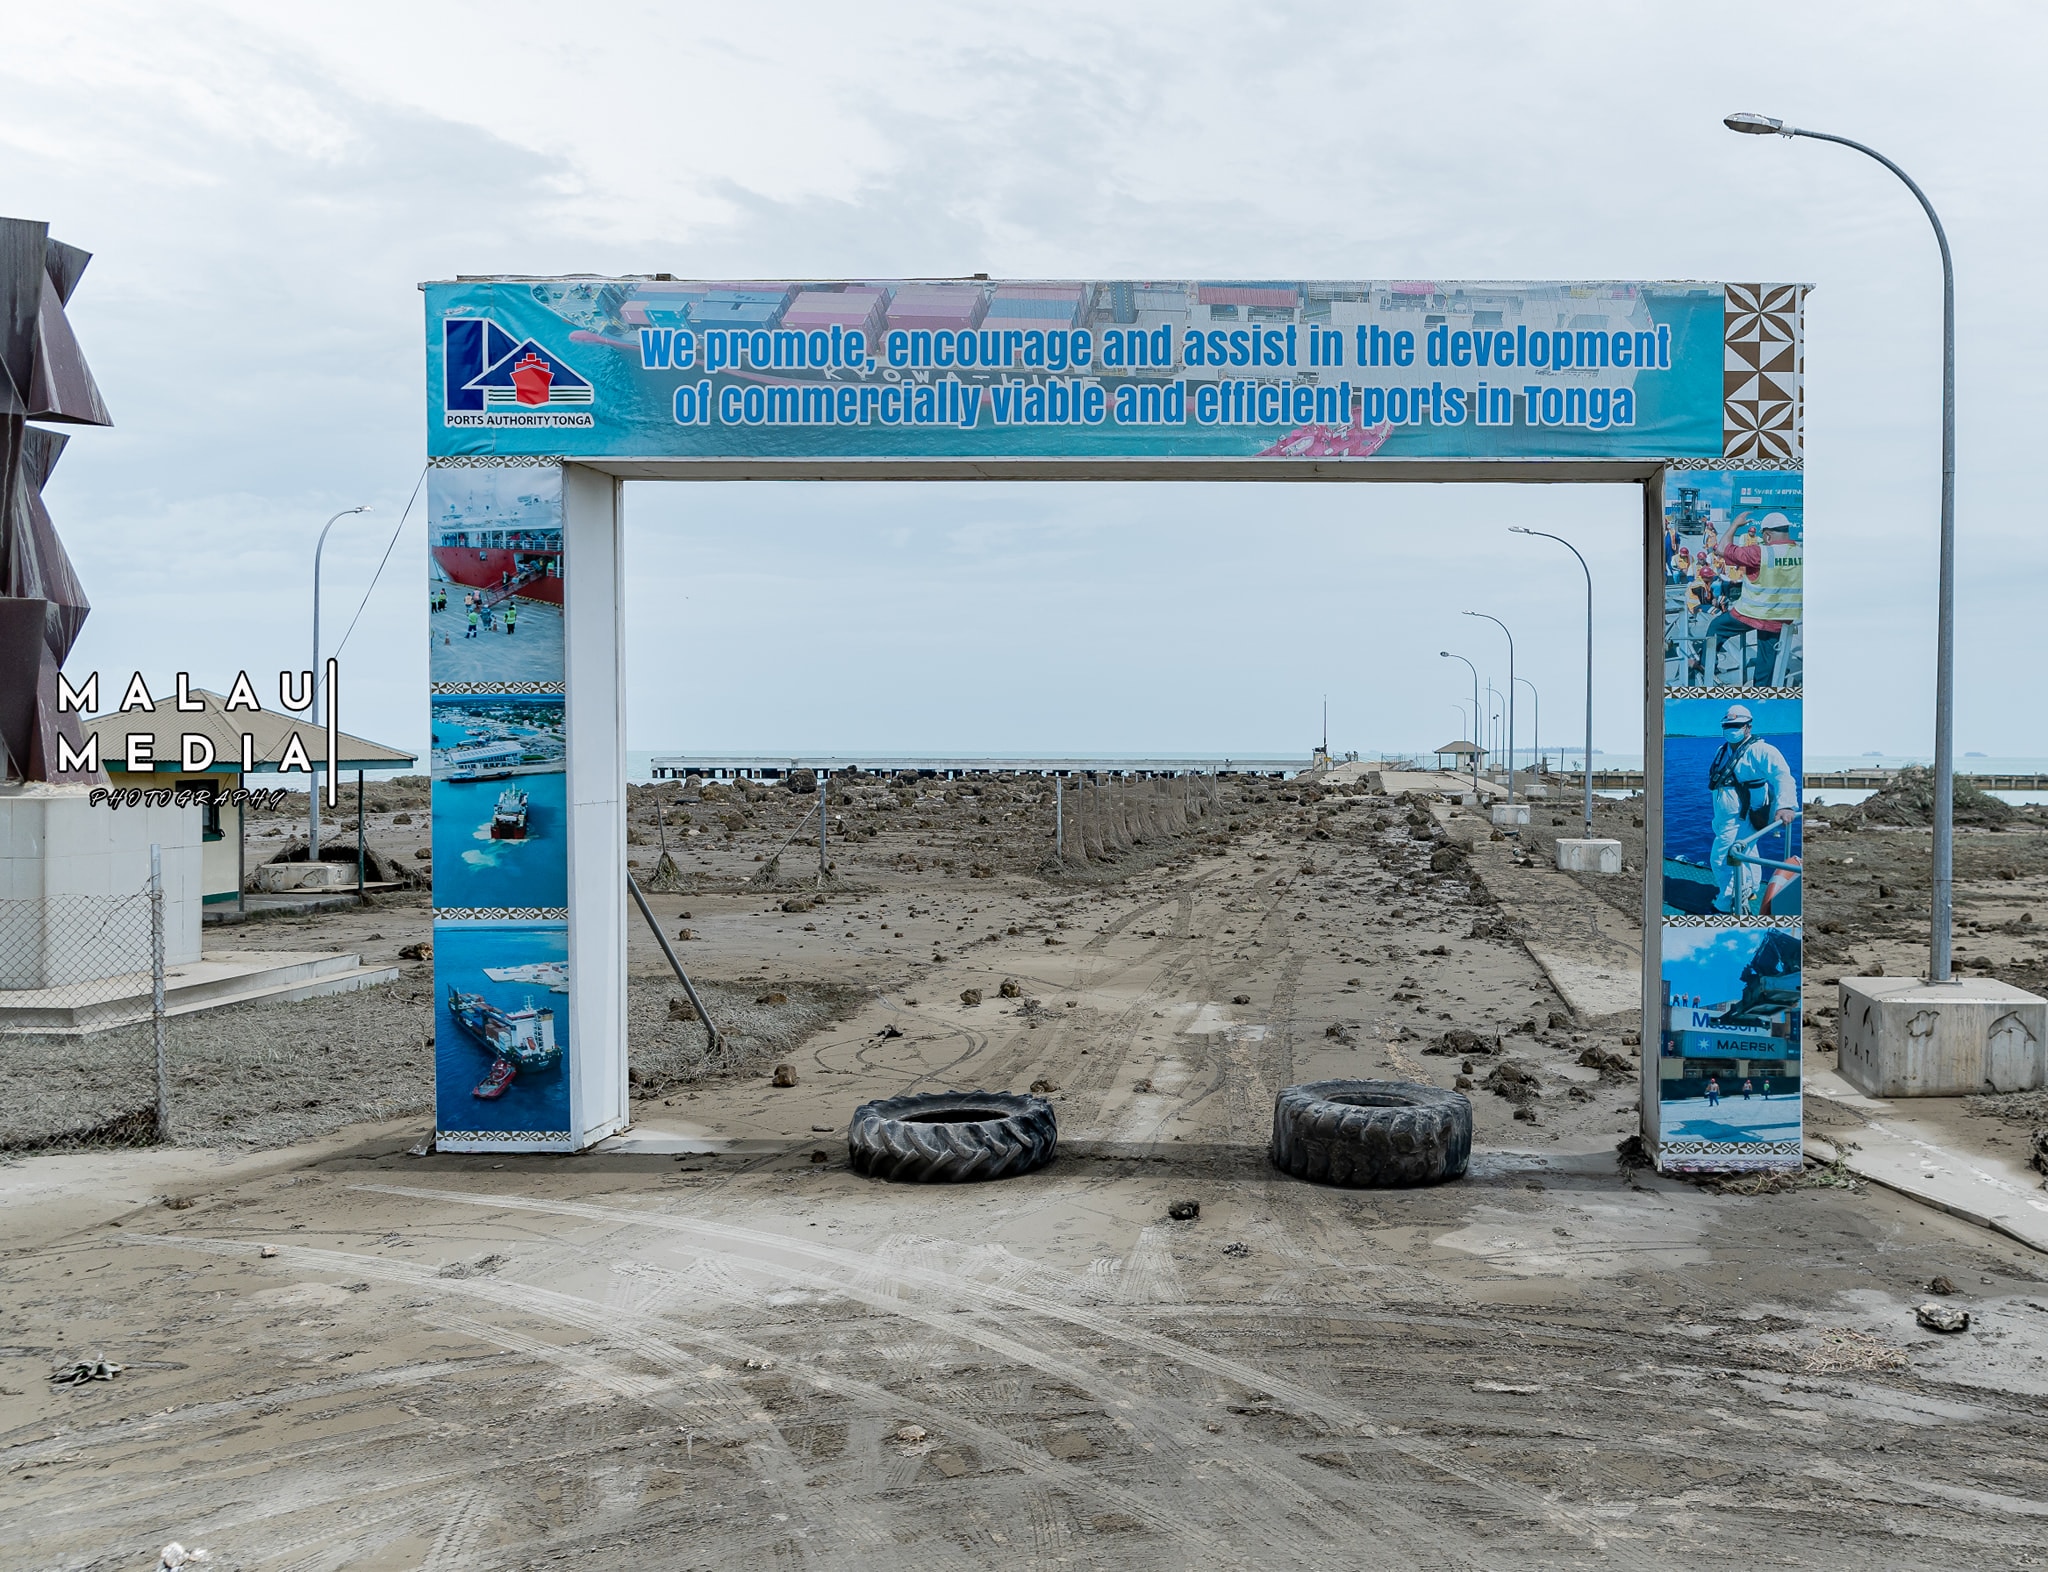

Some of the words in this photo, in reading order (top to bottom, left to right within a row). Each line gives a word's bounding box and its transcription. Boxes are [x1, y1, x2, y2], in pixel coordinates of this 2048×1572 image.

[640, 329, 695, 368] We
[706, 325, 876, 372] promote,
[887, 330, 1092, 370] encourage
[1103, 324, 1172, 367] and
[1184, 324, 1298, 367] assist
[1309, 324, 1344, 367] in
[1355, 324, 1415, 367] the
[1427, 324, 1670, 371] development
[674, 380, 711, 424] of
[721, 380, 982, 427] commercially
[991, 380, 1106, 424] viable
[1114, 380, 1185, 424] and
[1197, 380, 1351, 424] efficient
[1363, 381, 1466, 428] ports
[1477, 381, 1512, 424] in
[1523, 384, 1634, 429] Tonga
[446, 415, 484, 425] PORTS
[486, 415, 551, 425] AUTHORITY
[553, 415, 592, 426] TONGA
[1716, 1040, 1776, 1053] MAERSK
